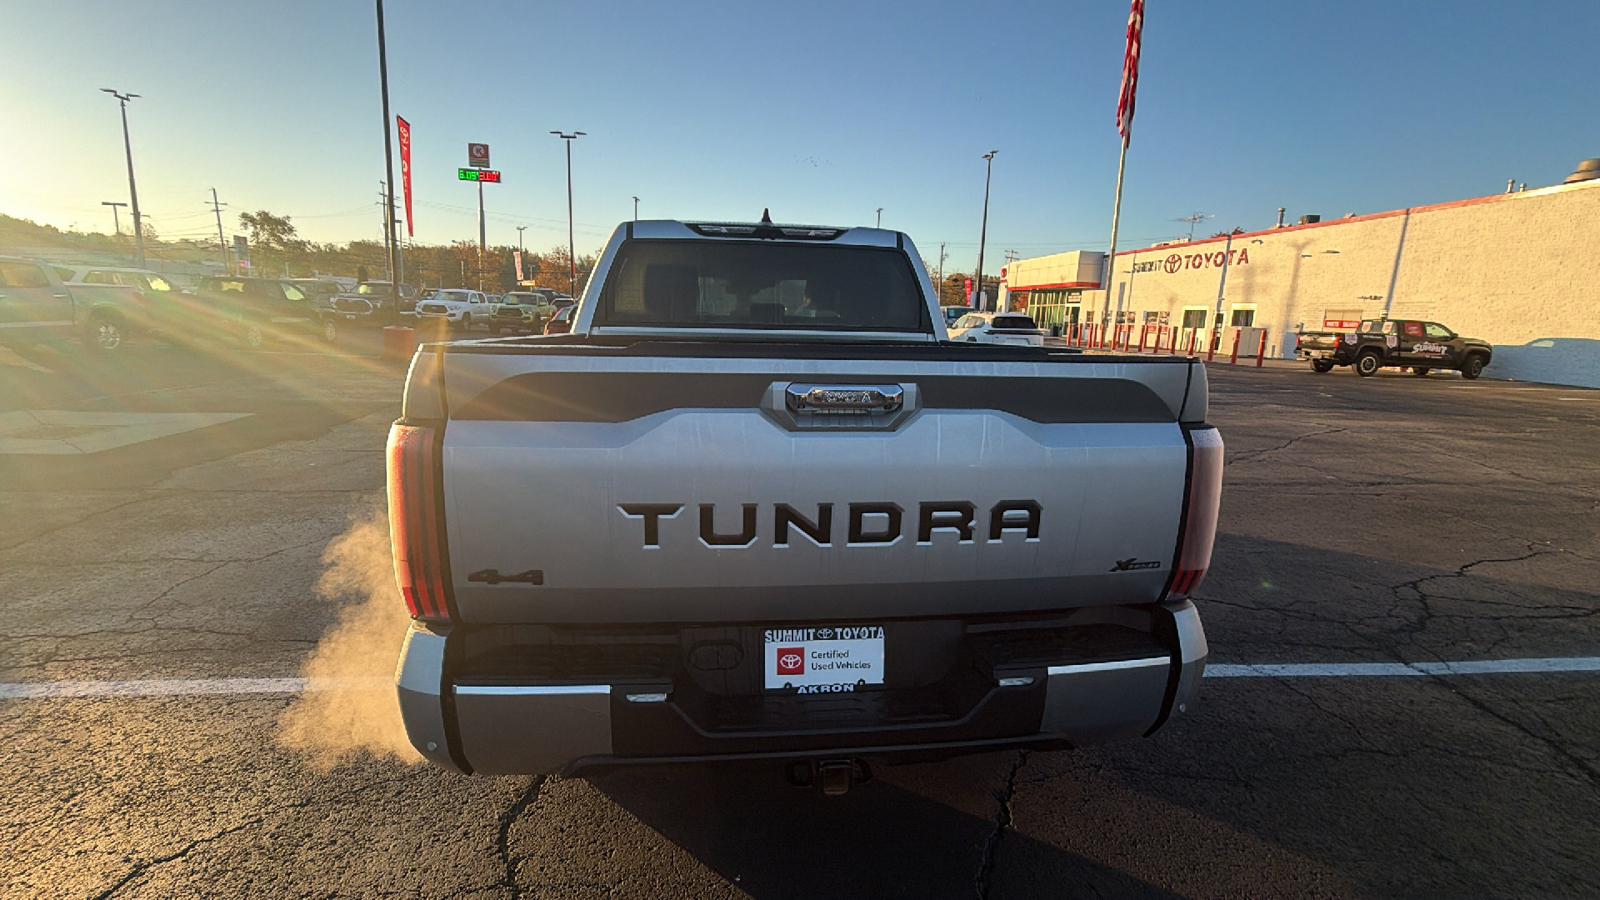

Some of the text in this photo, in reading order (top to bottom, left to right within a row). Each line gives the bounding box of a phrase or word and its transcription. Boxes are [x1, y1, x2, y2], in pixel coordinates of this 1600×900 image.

[1184, 248, 1249, 270] TOYOTA
[616, 499, 1044, 549] TUNDRA
[764, 626, 886, 643] SUMMIT TOYOTA
[811, 650, 850, 659] Certified
[811, 660, 872, 671] Used Vehicles
[796, 683, 855, 695] AKRON
